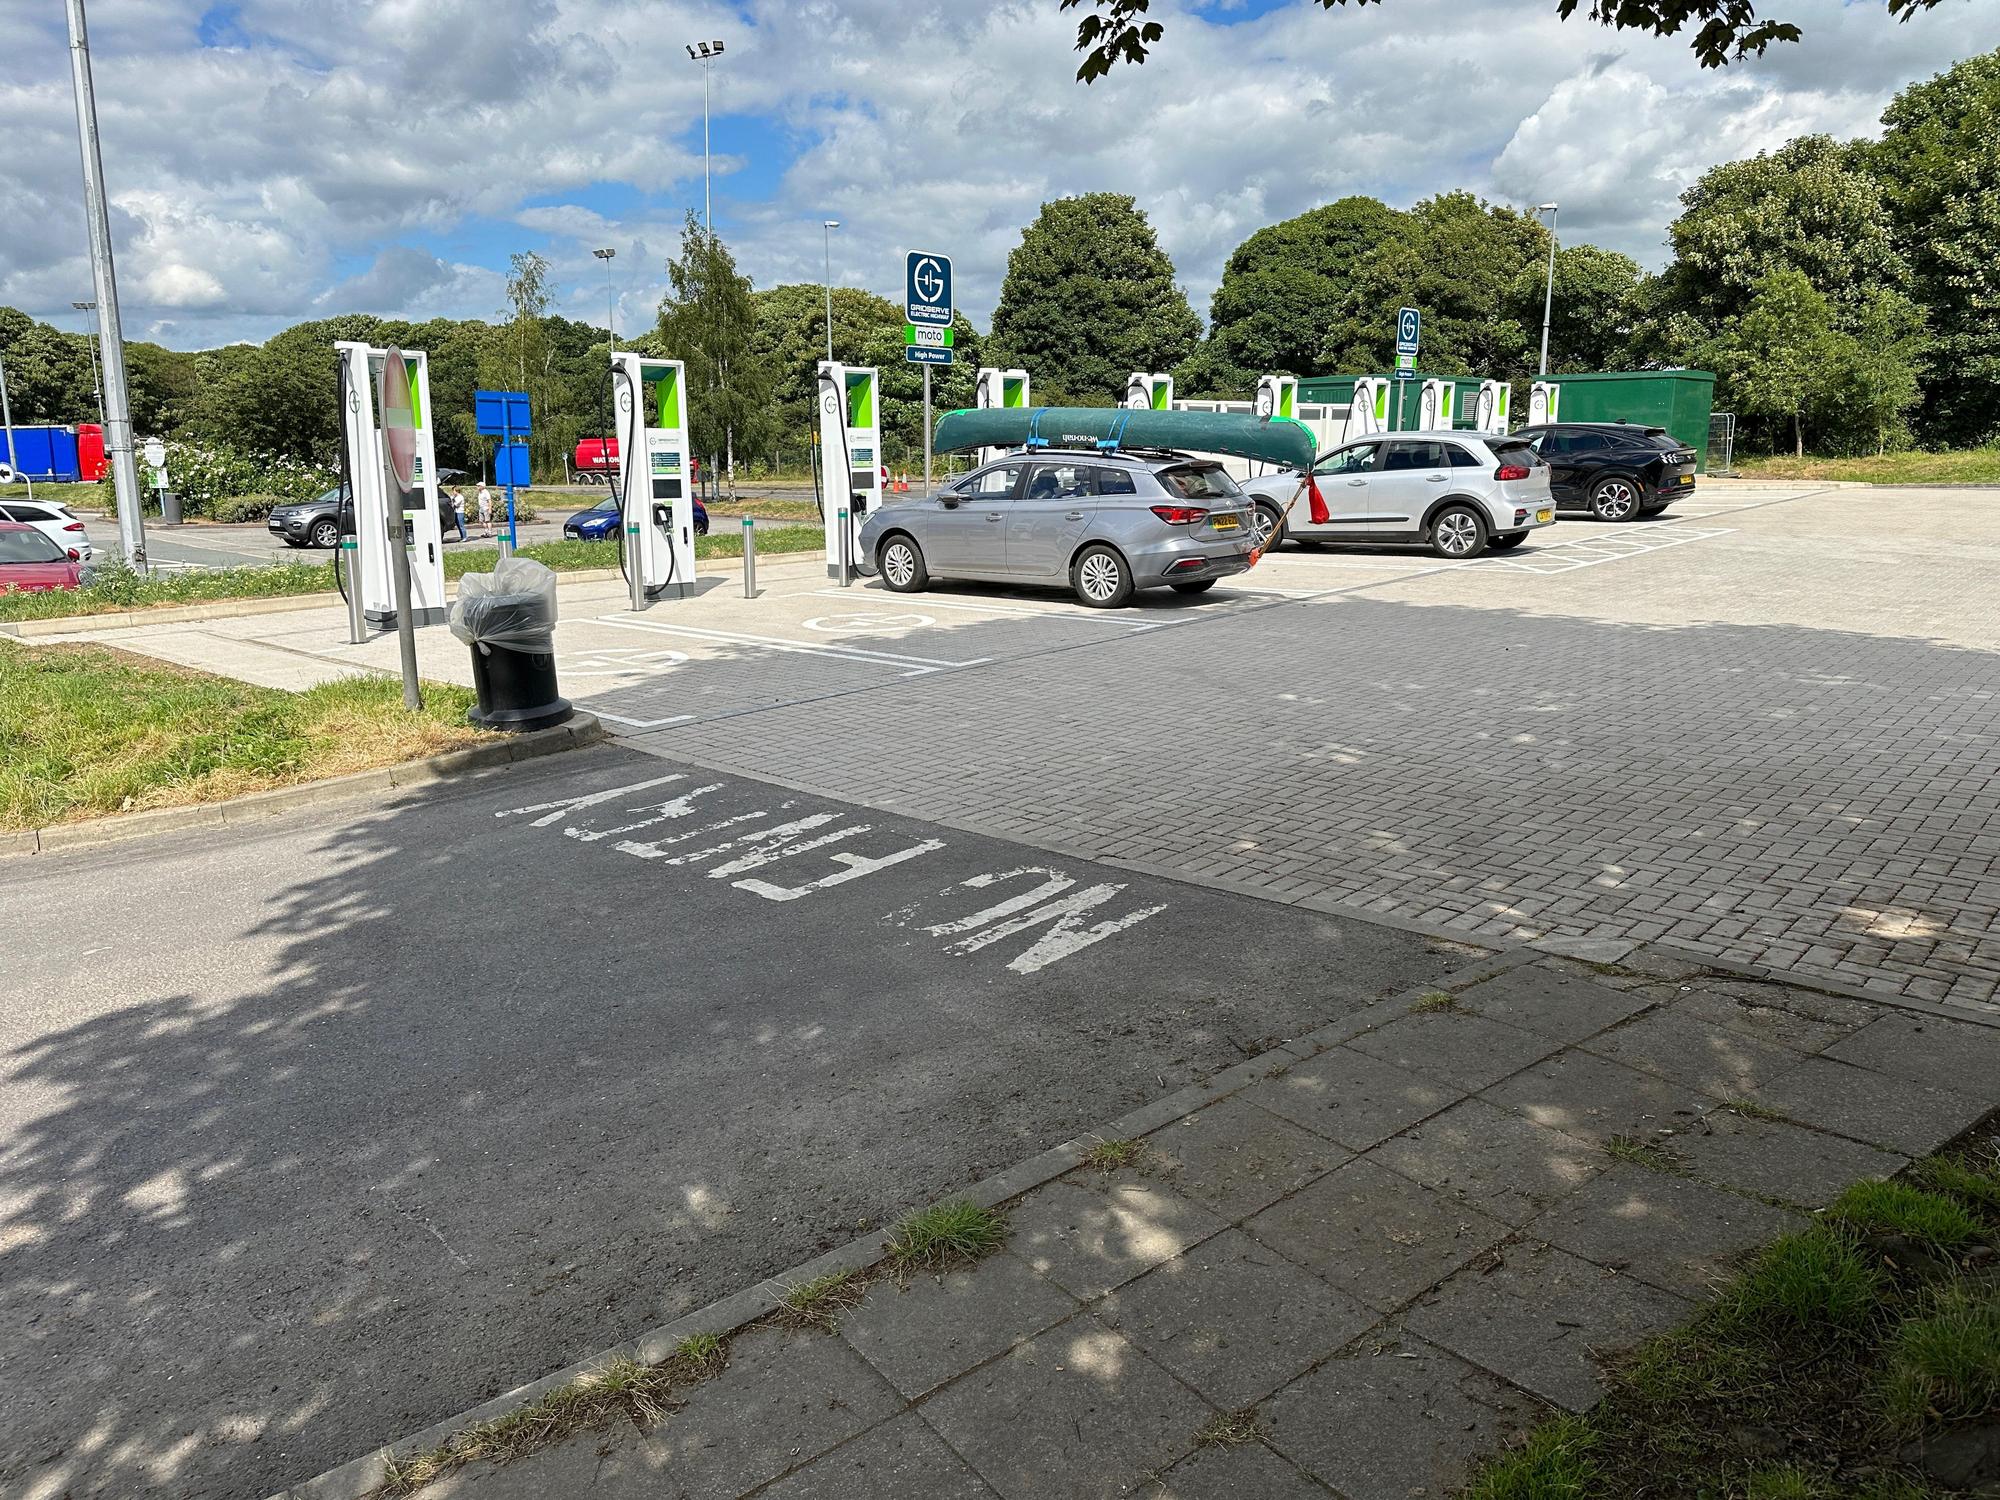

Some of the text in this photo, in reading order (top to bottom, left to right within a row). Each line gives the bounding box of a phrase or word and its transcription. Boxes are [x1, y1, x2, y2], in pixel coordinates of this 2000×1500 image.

[911, 304, 949, 314] GRIDSERVE
[918, 330, 942, 340] moto
[915, 351, 946, 360] High Power
[592, 456, 620, 464] WATON
